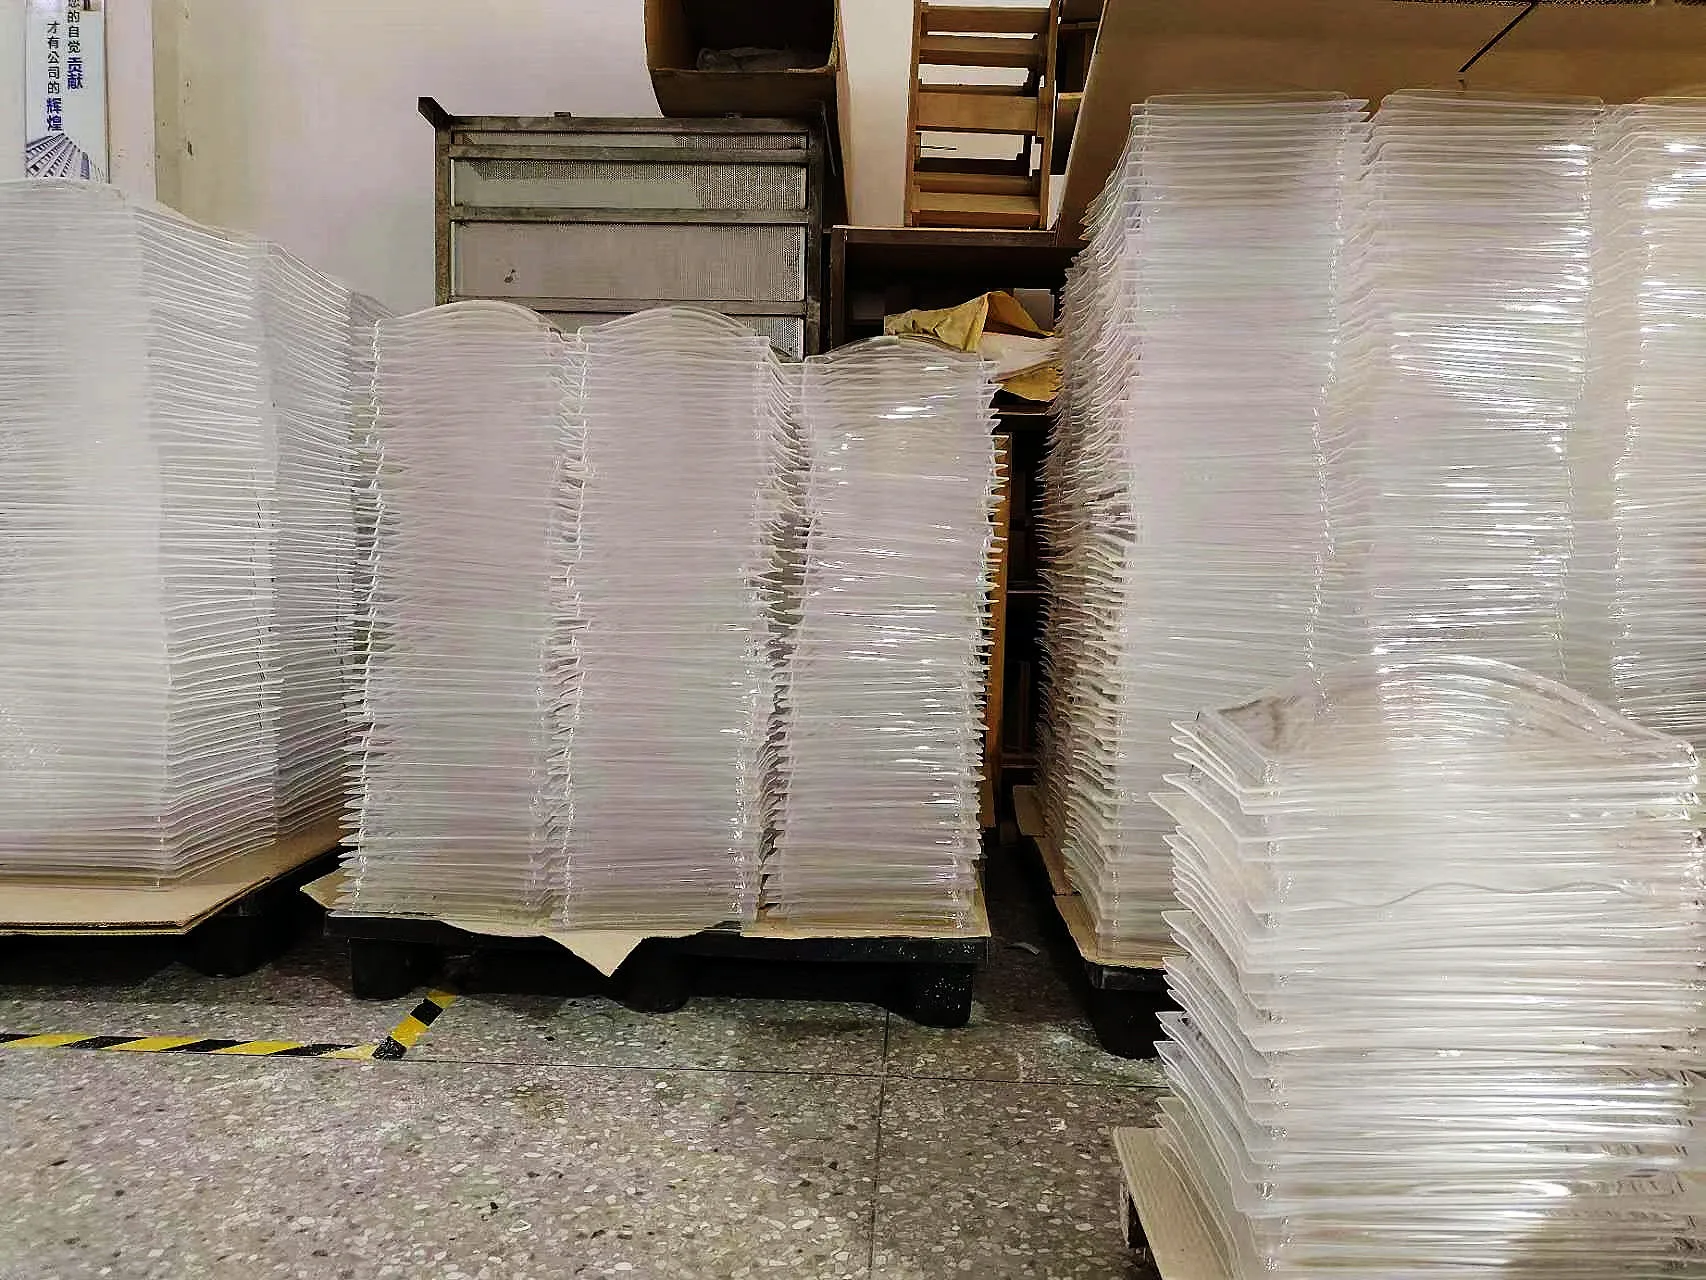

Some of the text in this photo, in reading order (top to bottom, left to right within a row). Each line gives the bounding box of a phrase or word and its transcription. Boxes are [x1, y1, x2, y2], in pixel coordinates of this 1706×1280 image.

[47, 21, 62, 132] 才有公司的辉煌
